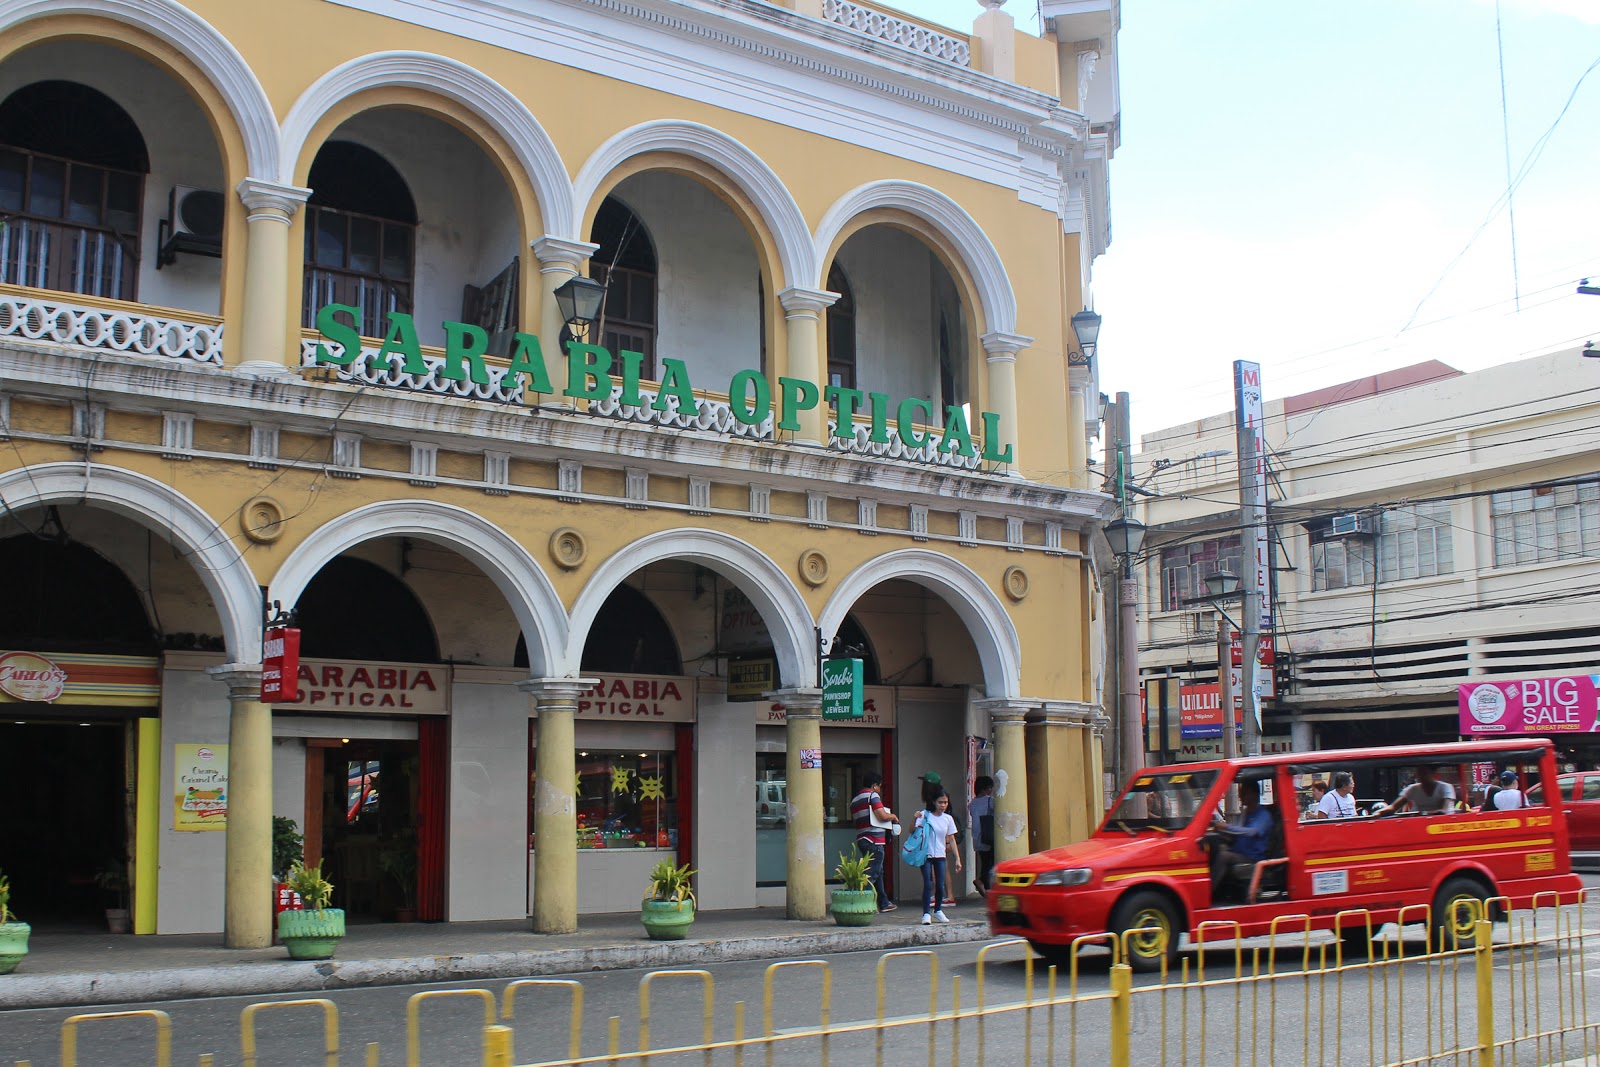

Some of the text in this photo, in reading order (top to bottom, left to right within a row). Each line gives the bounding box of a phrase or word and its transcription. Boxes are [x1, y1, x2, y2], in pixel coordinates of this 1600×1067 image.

[316, 303, 1013, 464] SARABIA OPTICAL
[298, 664, 437, 692] ARABIA
[740, 672, 764, 683] UNION
[823, 667, 853, 690] Sarabia
[580, 678, 682, 701] RABIA
[824, 692, 851, 700] PAWNSHOP
[1521, 677, 1579, 708] BIG
[577, 700, 665, 716] PTICAL
[825, 705, 850, 714] JEWELRY
[1523, 705, 1581, 725] SALE
